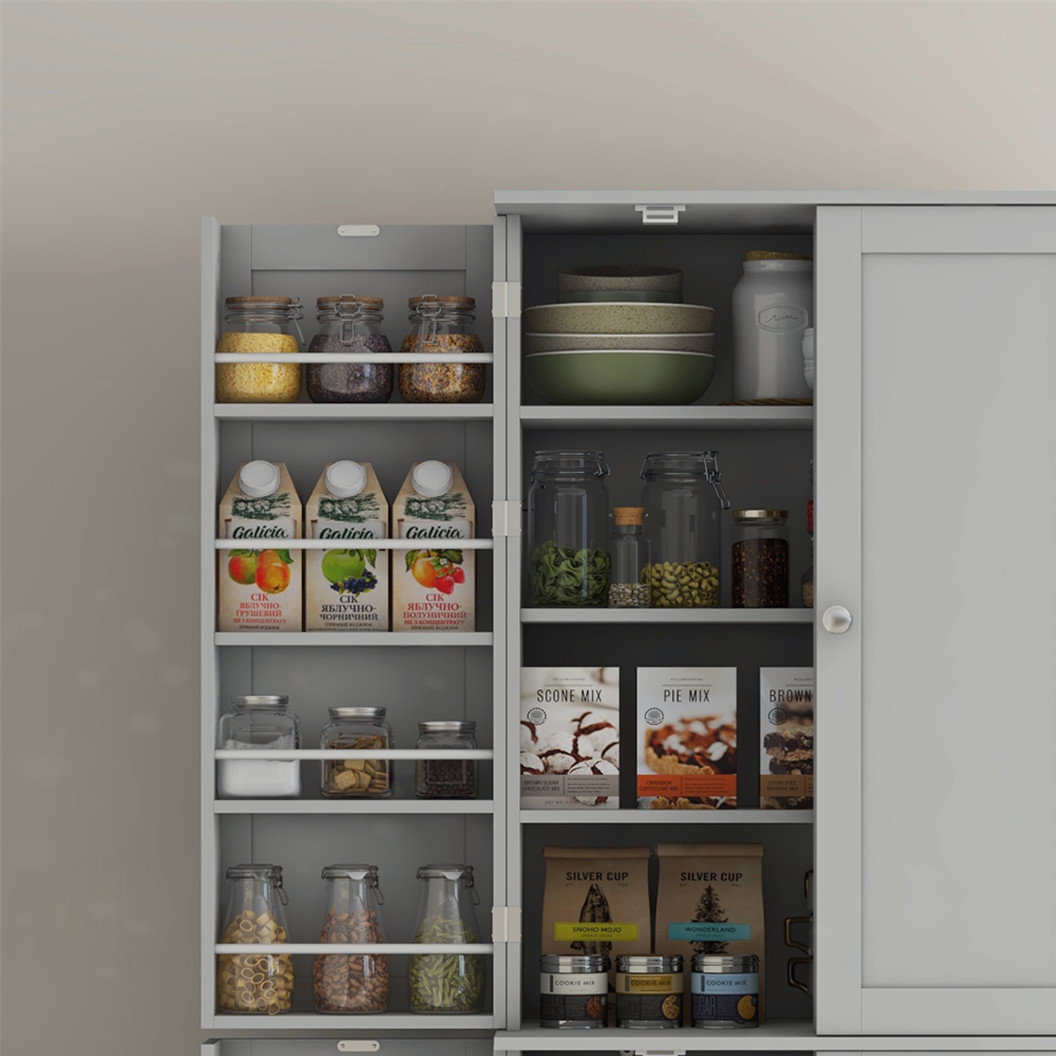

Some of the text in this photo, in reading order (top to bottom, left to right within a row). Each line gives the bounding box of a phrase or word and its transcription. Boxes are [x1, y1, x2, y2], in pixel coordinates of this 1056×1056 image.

[232, 525, 289, 539] Galicia
[406, 525, 465, 539] Galicia
[250, 593, 269, 601] СІК
[339, 594, 358, 603] СІК
[425, 593, 445, 601] СІК
[320, 604, 377, 613] ЯБЛУЧНО-
[407, 602, 462, 611] ЯБЛУЧНО-
[536, 689, 602, 703] SCONE MIX
[663, 689, 711, 703] PIE MIX
[769, 688, 812, 703] BROWN
[566, 871, 629, 881] SILVER CUP
[680, 871, 743, 881] SILVER CUP
